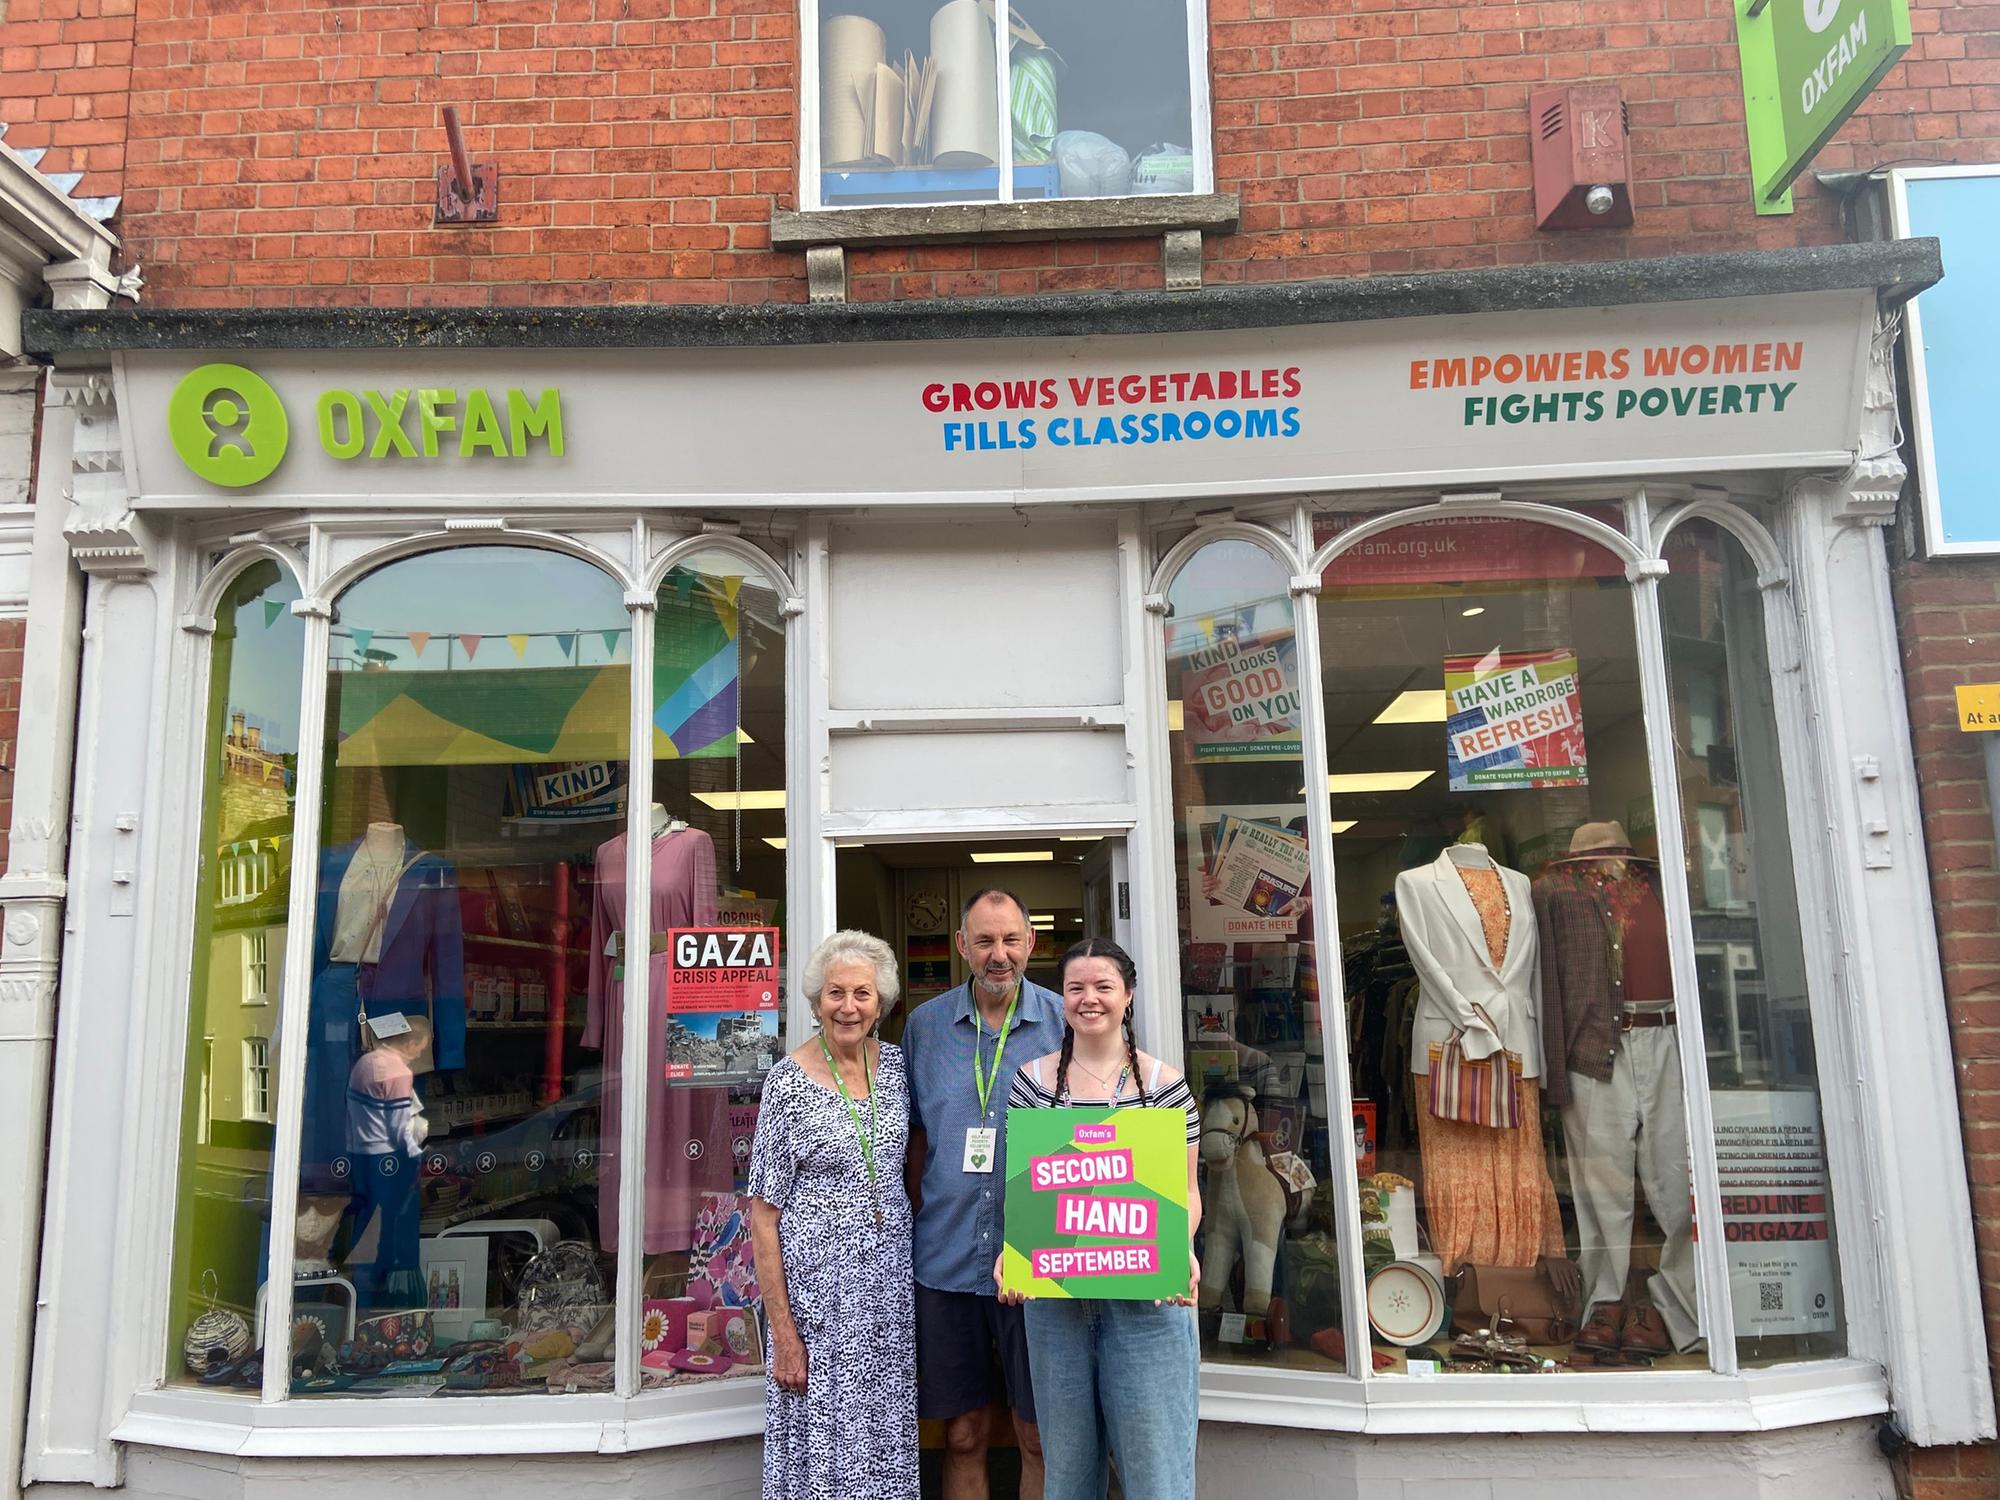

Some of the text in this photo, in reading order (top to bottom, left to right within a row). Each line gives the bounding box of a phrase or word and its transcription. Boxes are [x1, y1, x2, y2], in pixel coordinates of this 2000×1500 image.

[1801, 9, 1867, 114] OXFAM
[1410, 342, 1803, 389] EMPOWERS WOMEN
[922, 367, 1301, 413] GROWS VEGETABLES
[1464, 382, 1797, 425] FIGHTS POVERTY
[317, 387, 564, 460] OXFAM
[944, 407, 1300, 451] FILLS CLASSROOMS
[1191, 641, 1239, 670] KIND
[1230, 650, 1277, 675] LOOKS
[1207, 667, 1282, 710] GOOD
[1457, 669, 1535, 708] HAVE A
[1485, 678, 1575, 720] WARDROBE
[1232, 690, 1300, 721] ON YOU
[1967, 712, 2000, 724] At a
[1459, 703, 1568, 757] REFRESH
[543, 764, 605, 800] KIND
[1258, 872, 1297, 897] ERASURE
[1228, 920, 1293, 930] DONATE HERE
[677, 934, 772, 967] GAZA
[673, 970, 772, 984] CRISIS APPEAL
[1078, 1130, 1111, 1139] Oxfam's
[1036, 1155, 1127, 1186] SECOND
[1064, 1199, 1148, 1235] HAND
[1720, 1195, 1810, 1214] RED LINE
[1725, 1222, 1817, 1242] OR GAZA
[1038, 1249, 1150, 1274] SEPTEMBER
